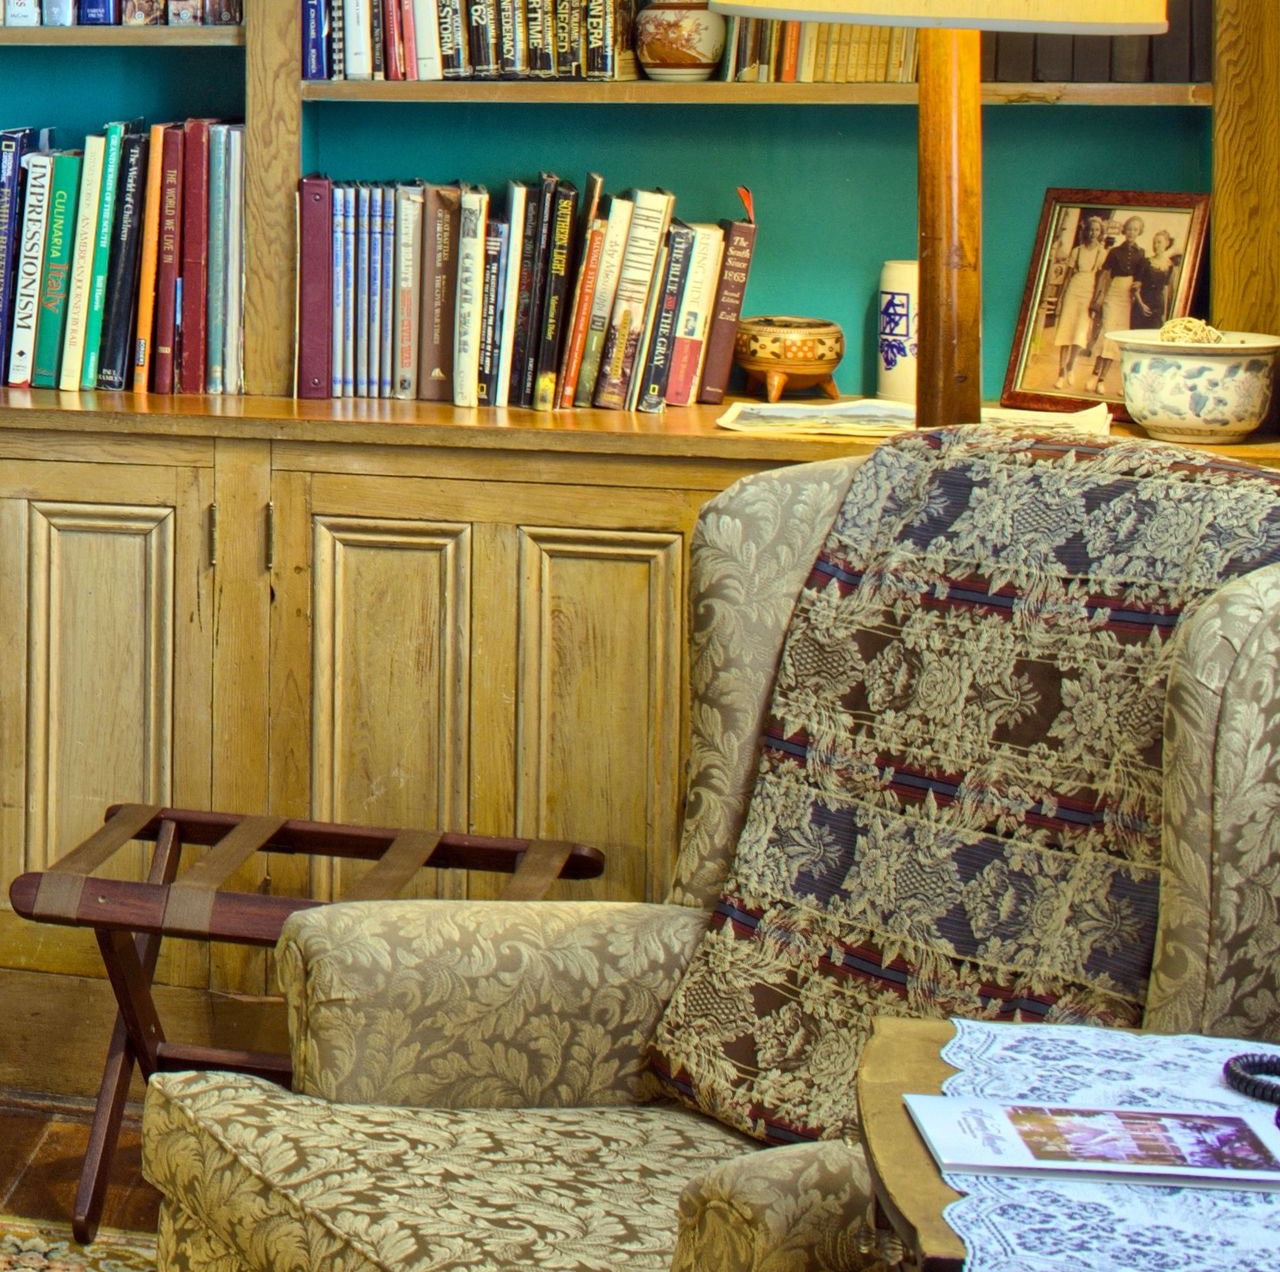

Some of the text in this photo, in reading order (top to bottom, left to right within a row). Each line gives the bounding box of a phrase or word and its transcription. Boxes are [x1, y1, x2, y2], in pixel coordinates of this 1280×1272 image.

[436, 6, 454, 56] STORM
[528, 8, 542, 48] TIME
[588, 18, 603, 48] ERA
[120, 147, 140, 242] The World Children
[100, 219, 110, 248] SOUTH
[164, 169, 178, 264] THE WORLD WE LIVE IN
[632, 206, 663, 234] THE
[16, 164, 50, 330] IMPRESSIONISM
[40, 190, 70, 314] CULINARIA Italy
[551, 200, 572, 276] SOUTHERN LIGHT
[622, 236, 658, 272] CIVIL
[695, 232, 712, 272] RISING
[727, 247, 750, 259] South
[733, 236, 749, 247] The
[584, 235, 603, 292] SALVAGE STYLE
[723, 270, 746, 282] 1865
[726, 257, 748, 269] Since
[458, 253, 474, 354] CIVIL WAR
[617, 278, 649, 304] WAR
[653, 236, 686, 368] THE BLUE THE GRAY
[137, 339, 146, 366] BORDERS
